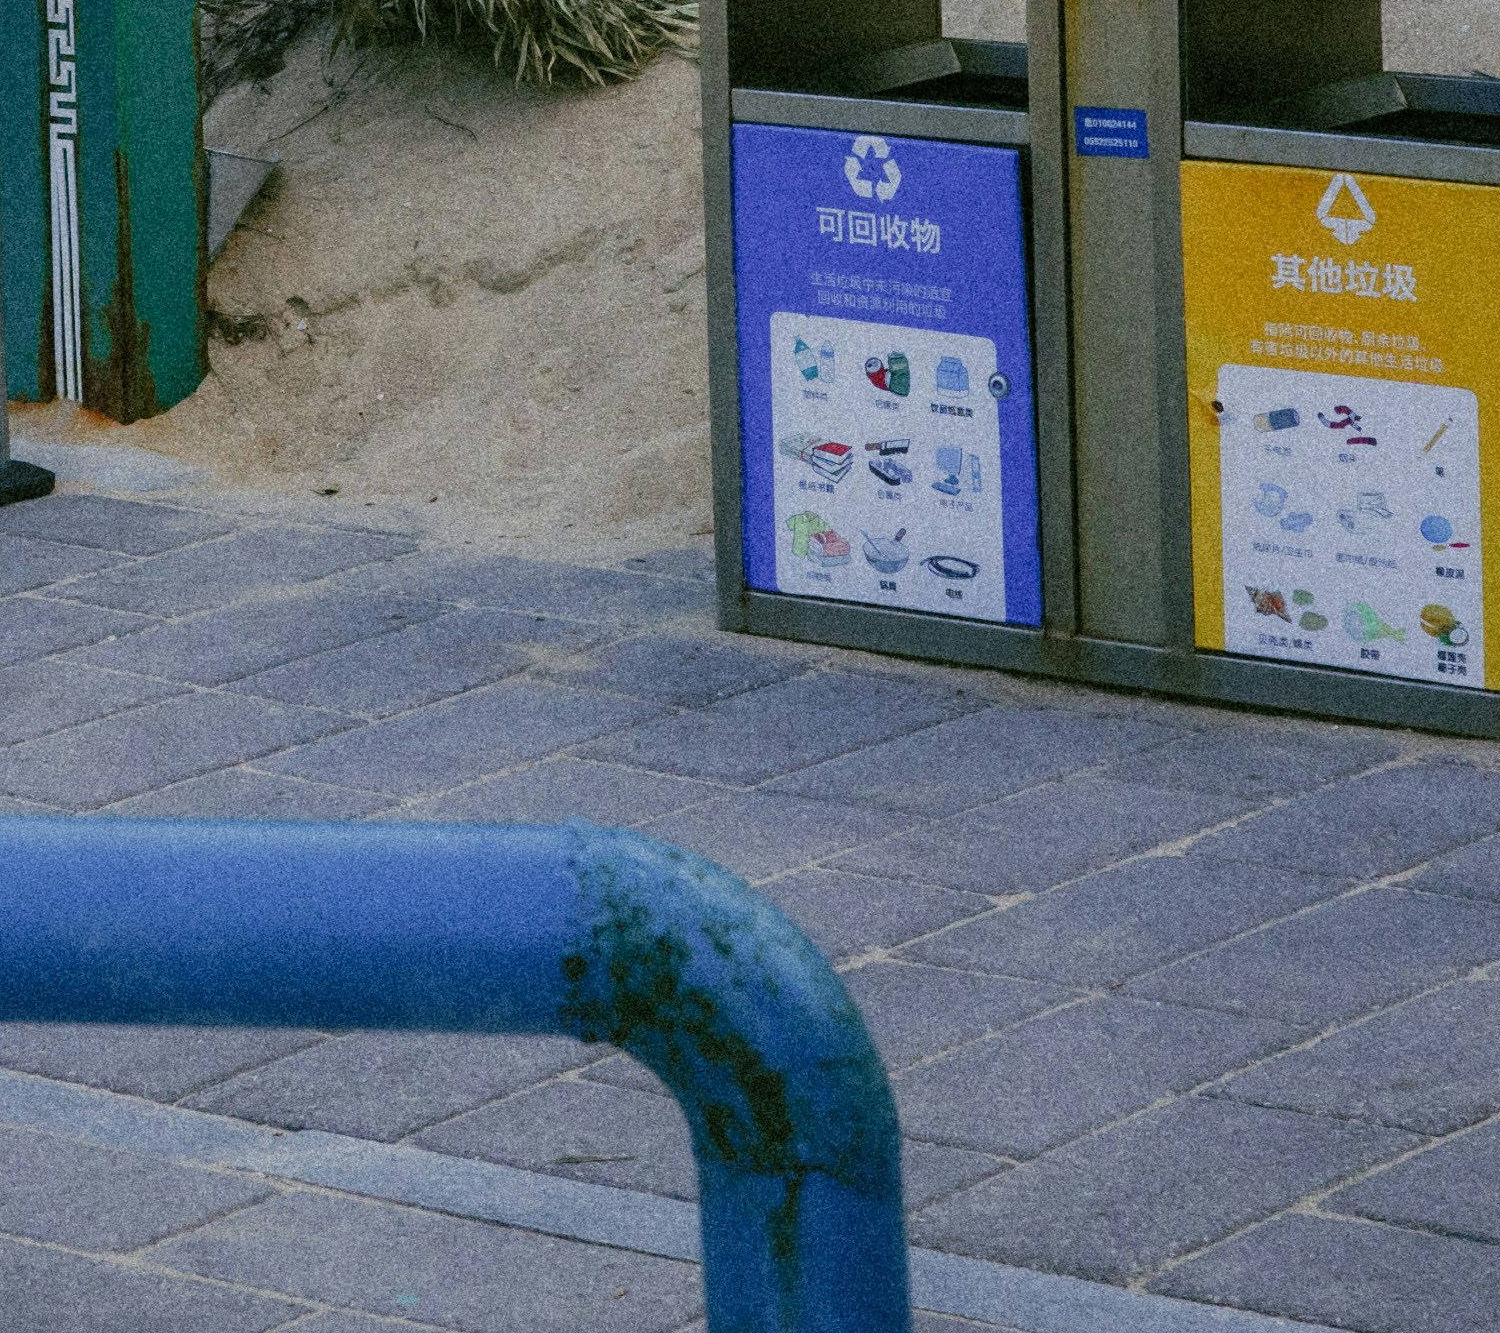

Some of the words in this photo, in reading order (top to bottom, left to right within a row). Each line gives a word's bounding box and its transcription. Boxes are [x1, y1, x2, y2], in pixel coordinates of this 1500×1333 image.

[815, 206, 941, 254] 可回收物
[1270, 252, 1418, 302] 其他垃圾
[817, 289, 947, 319] 回收和资源利用的垃圾
[1250, 339, 1445, 373] 有害垃圾以外的其他生活垃圾
